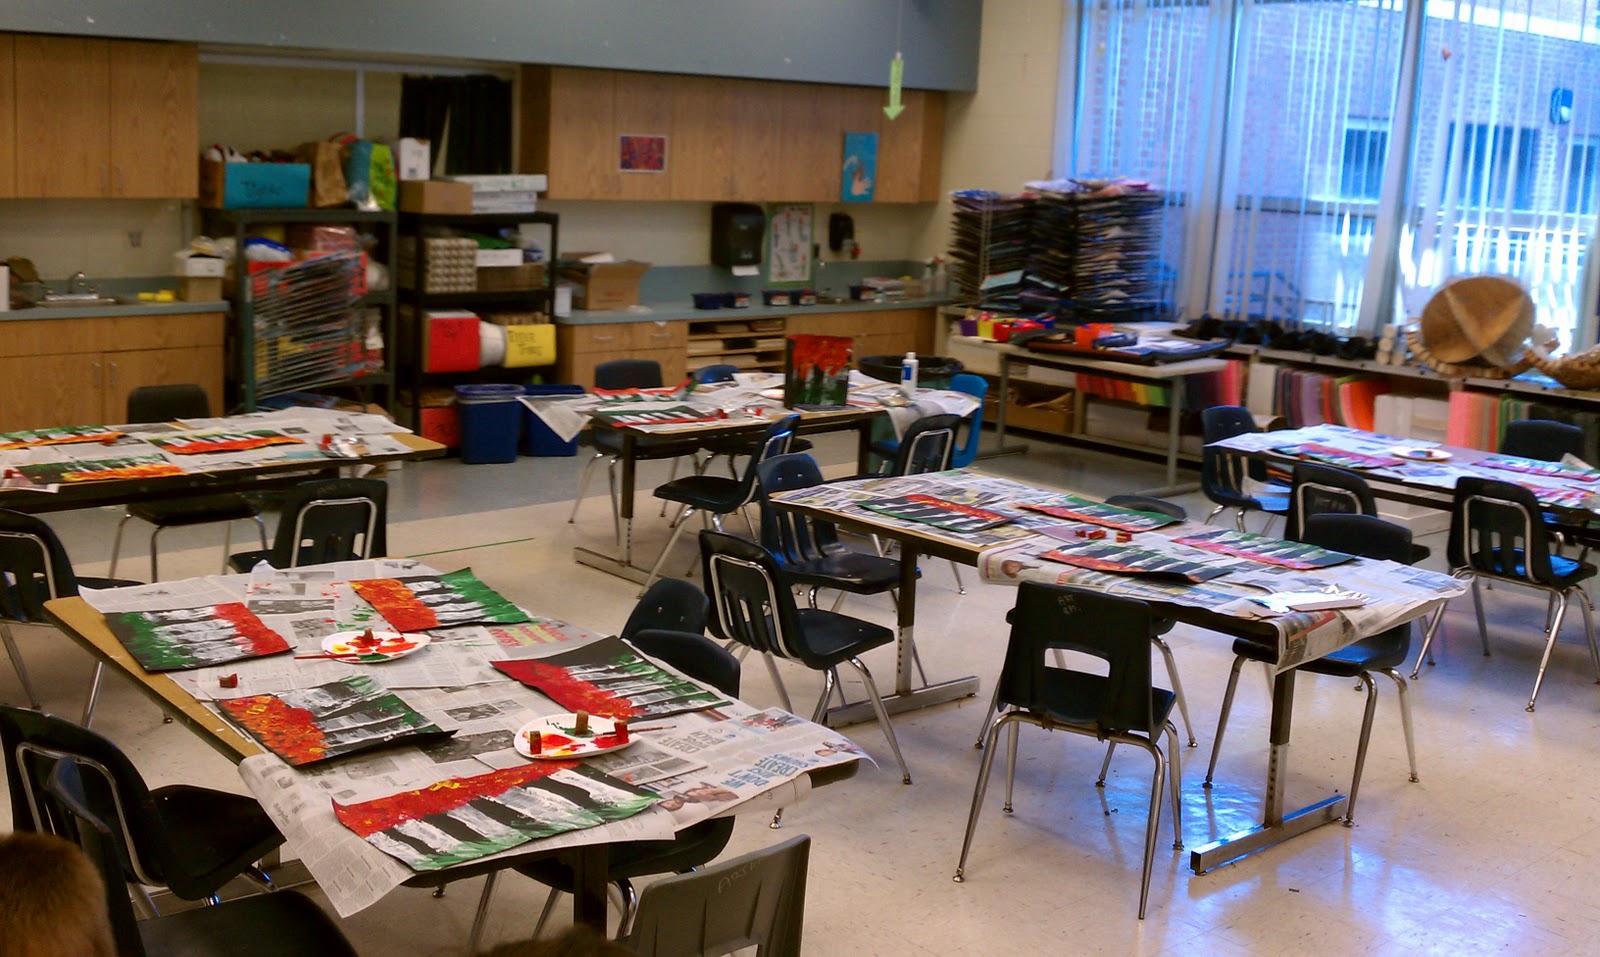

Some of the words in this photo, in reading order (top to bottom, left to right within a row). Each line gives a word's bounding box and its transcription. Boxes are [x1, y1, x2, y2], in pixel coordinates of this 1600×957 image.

[755, 757, 798, 776] CREATE
[721, 779, 745, 788] WE
[728, 769, 770, 786] DON'T
